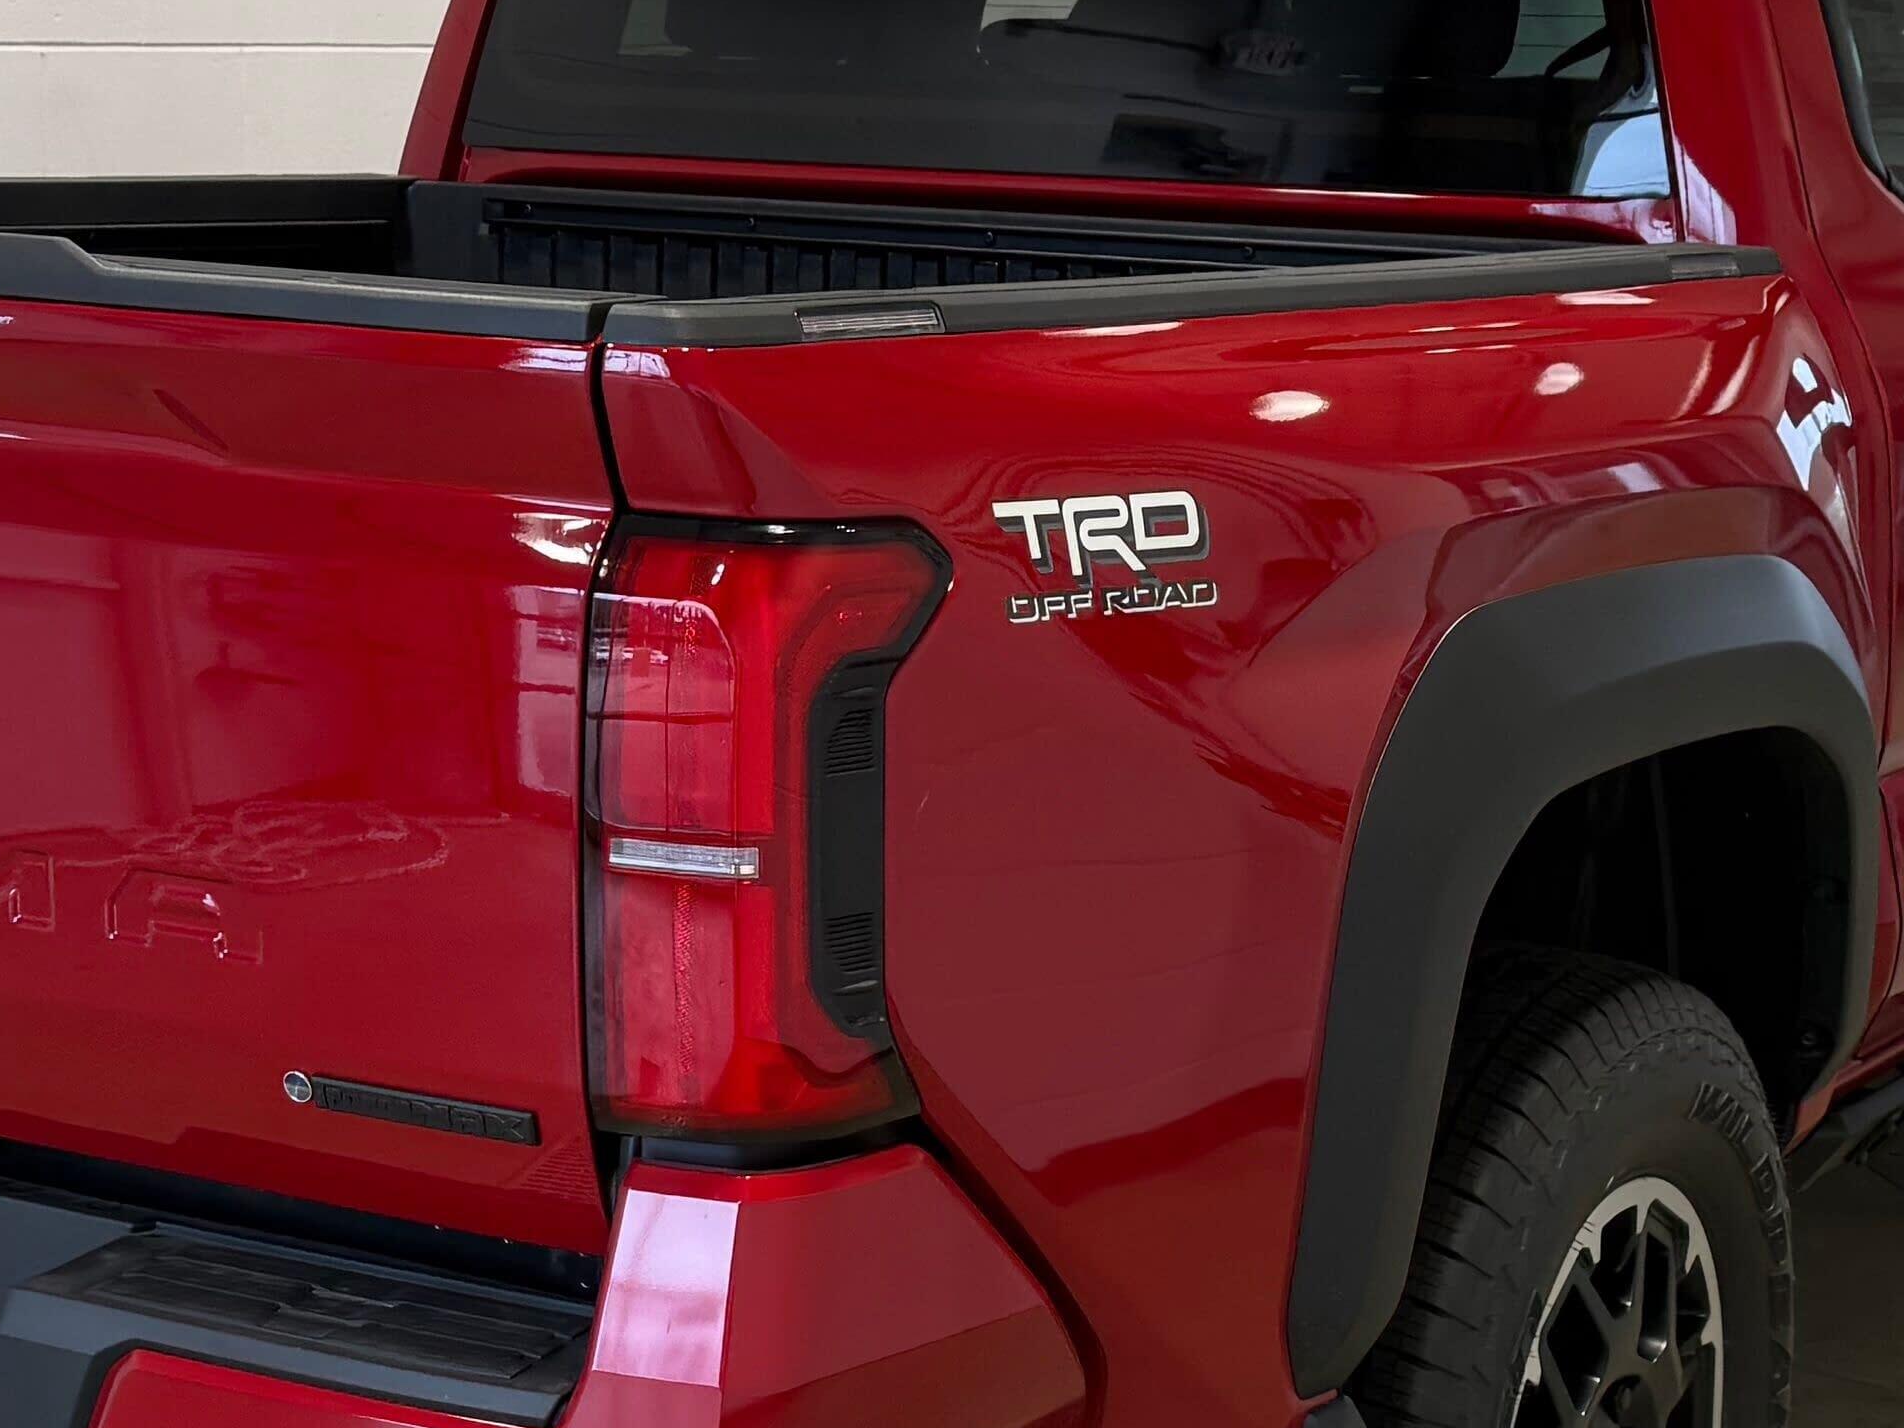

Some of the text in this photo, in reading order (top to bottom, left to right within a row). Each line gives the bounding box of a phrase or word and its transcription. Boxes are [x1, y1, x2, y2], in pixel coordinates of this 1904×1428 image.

[992, 490, 1206, 580] TRD
[1007, 581, 1218, 623] OFF ROAD
